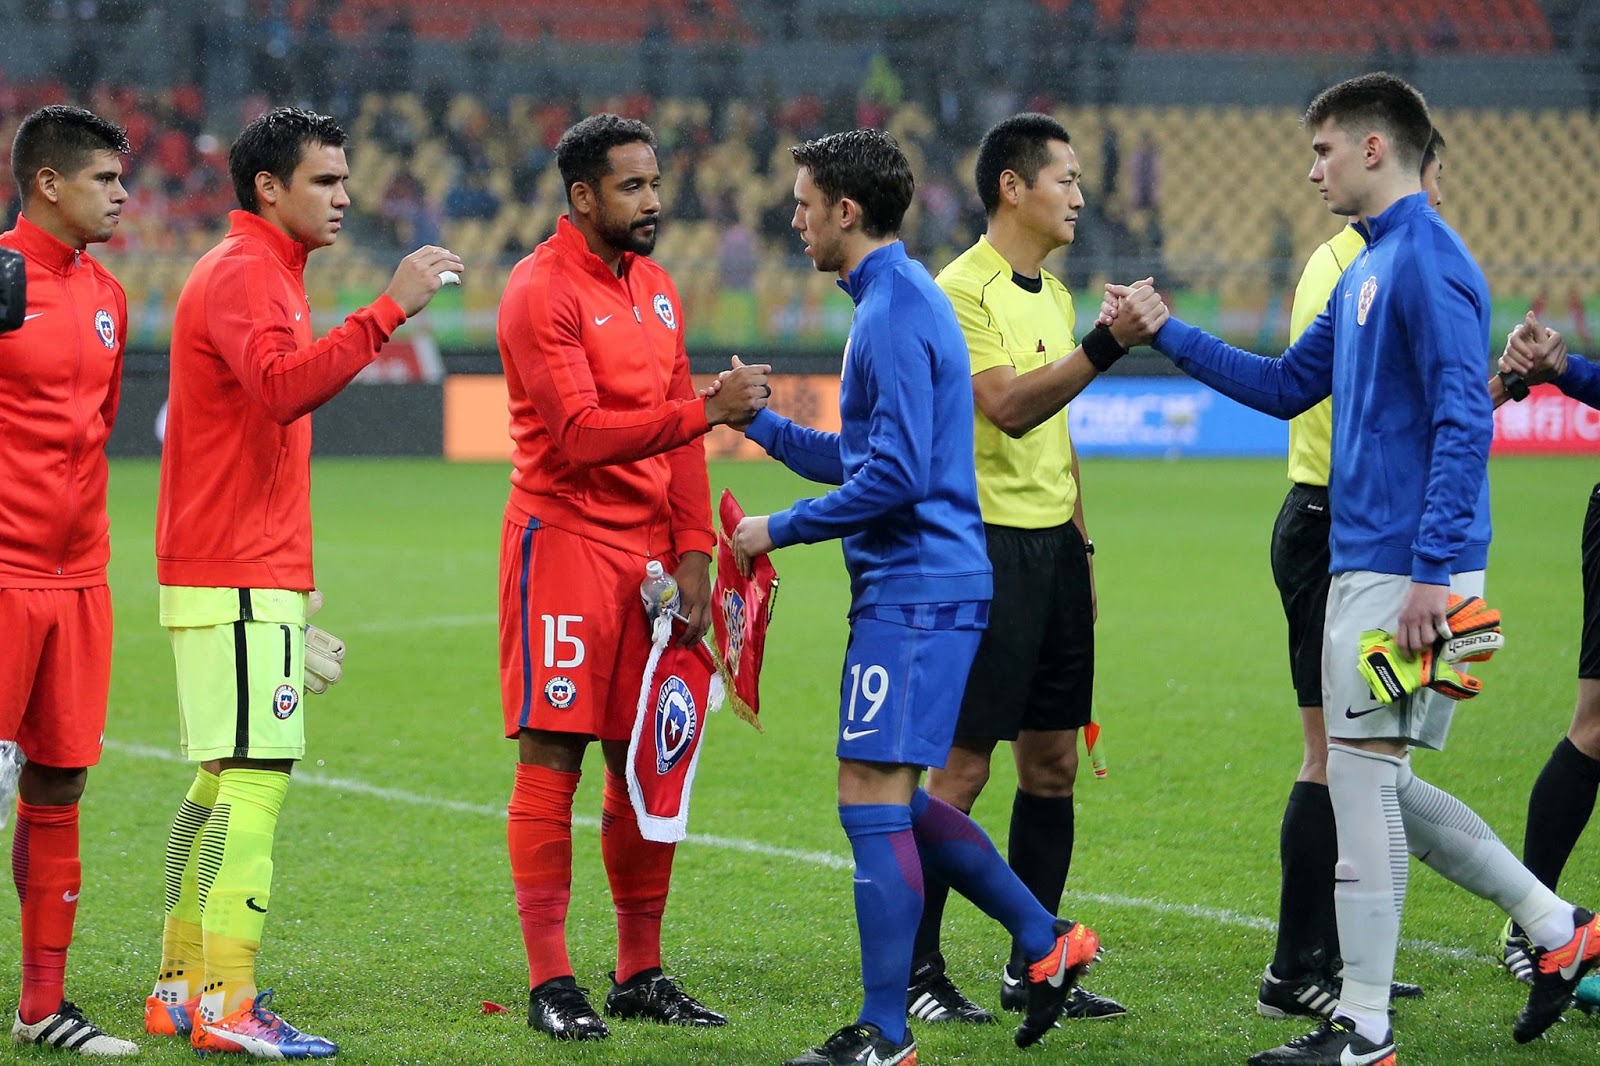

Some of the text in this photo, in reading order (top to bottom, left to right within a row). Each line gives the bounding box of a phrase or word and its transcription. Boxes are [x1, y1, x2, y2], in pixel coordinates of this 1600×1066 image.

[280, 624, 291, 678] 1
[541, 614, 586, 668] 15
[1449, 634, 1498, 654] reusch
[847, 663, 890, 722] 19
